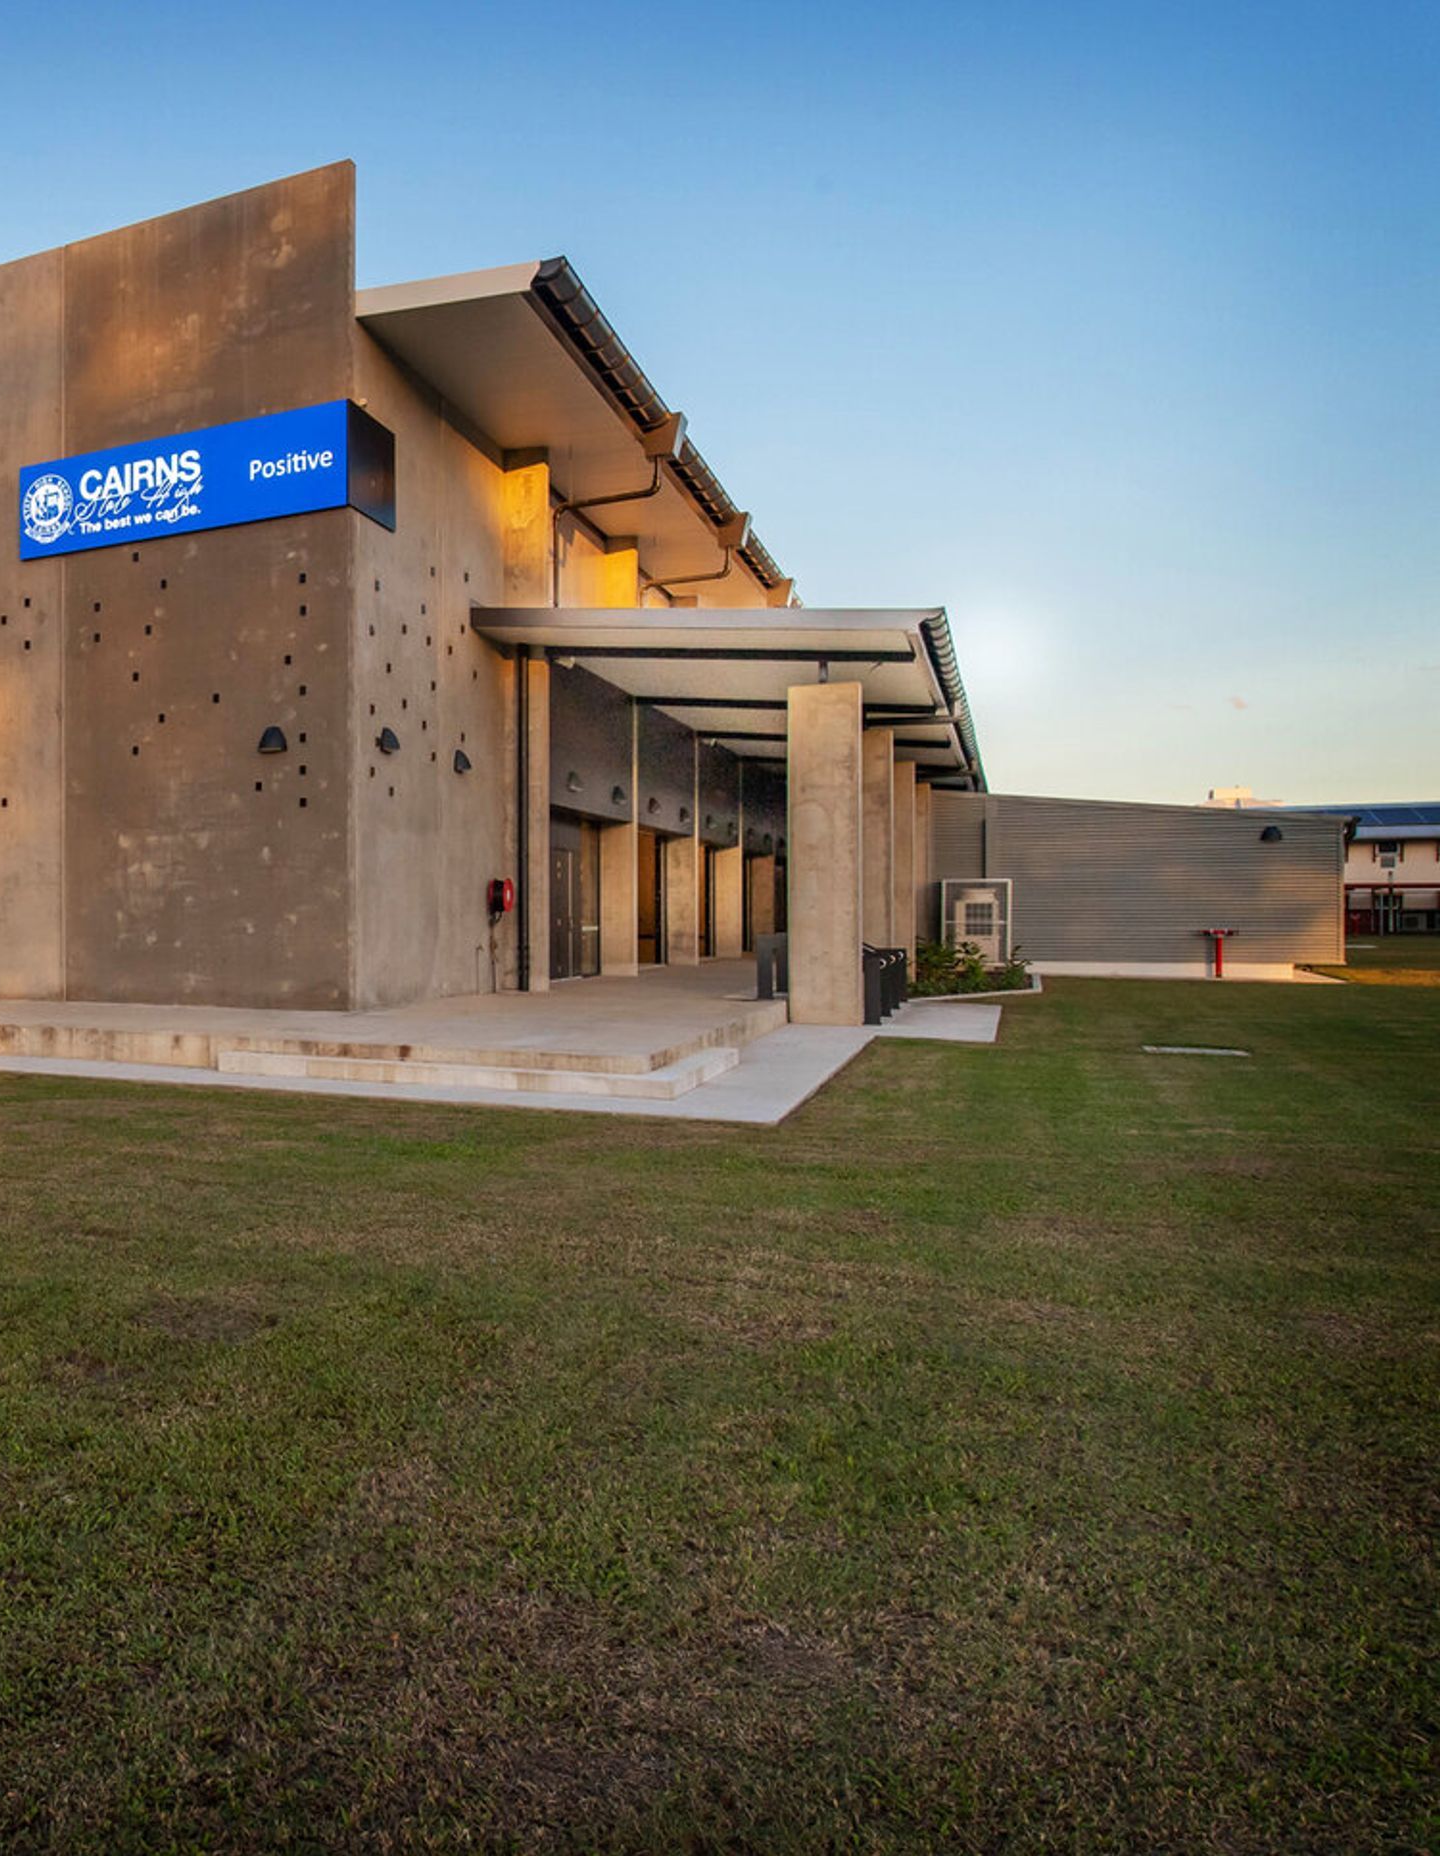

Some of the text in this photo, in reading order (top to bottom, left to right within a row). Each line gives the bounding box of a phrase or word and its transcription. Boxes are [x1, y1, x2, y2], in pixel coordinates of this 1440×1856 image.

[79, 450, 201, 500] CAIRNS
[249, 449, 334, 481] Positive
[79, 521, 102, 534] The
[104, 515, 131, 530] best
[134, 513, 152, 524] we
